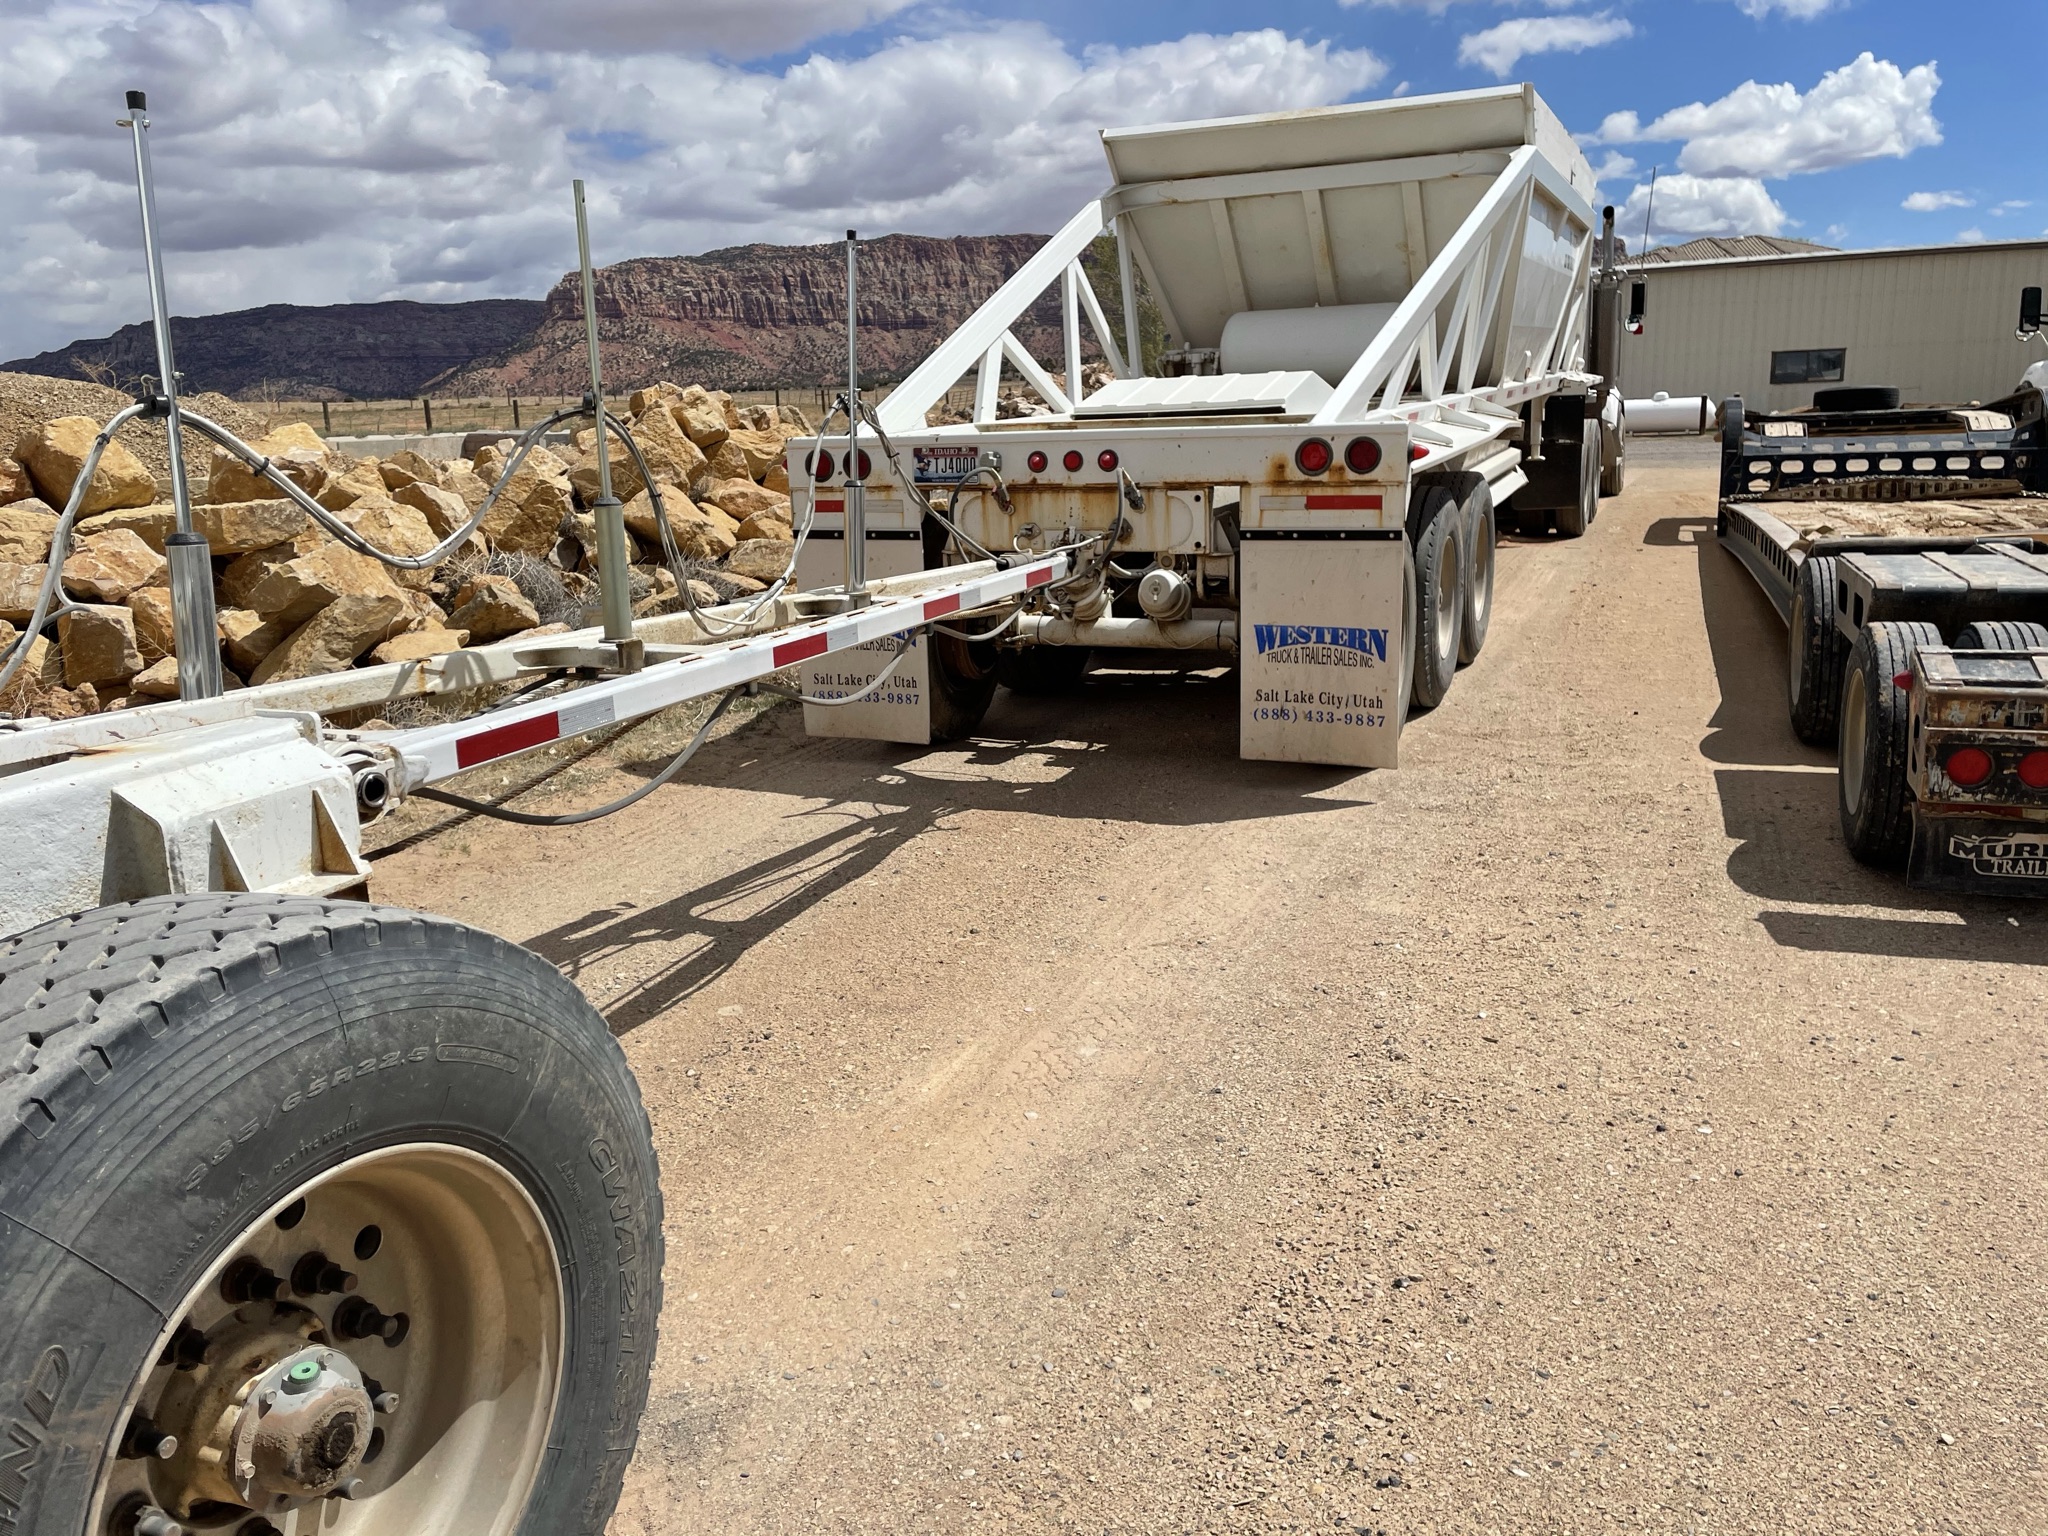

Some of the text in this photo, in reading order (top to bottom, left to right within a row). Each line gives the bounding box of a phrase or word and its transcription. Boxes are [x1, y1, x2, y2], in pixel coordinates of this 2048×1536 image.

[934, 457, 976, 474] TJ4000
[1253, 624, 1389, 663] WESTERN
[1266, 647, 1375, 669] TRUCK & TRAILER SALES INC.
[813, 672, 833, 685] Salt
[837, 673, 863, 687] Lake
[893, 675, 918, 689] Utah
[1255, 688, 1280, 703] Salt
[1284, 689, 1315, 704] Lake
[1353, 693, 1383, 709] Utah
[1253, 707, 1386, 728] (888) 433-9887
[1952, 839, 2048, 859] MUR
